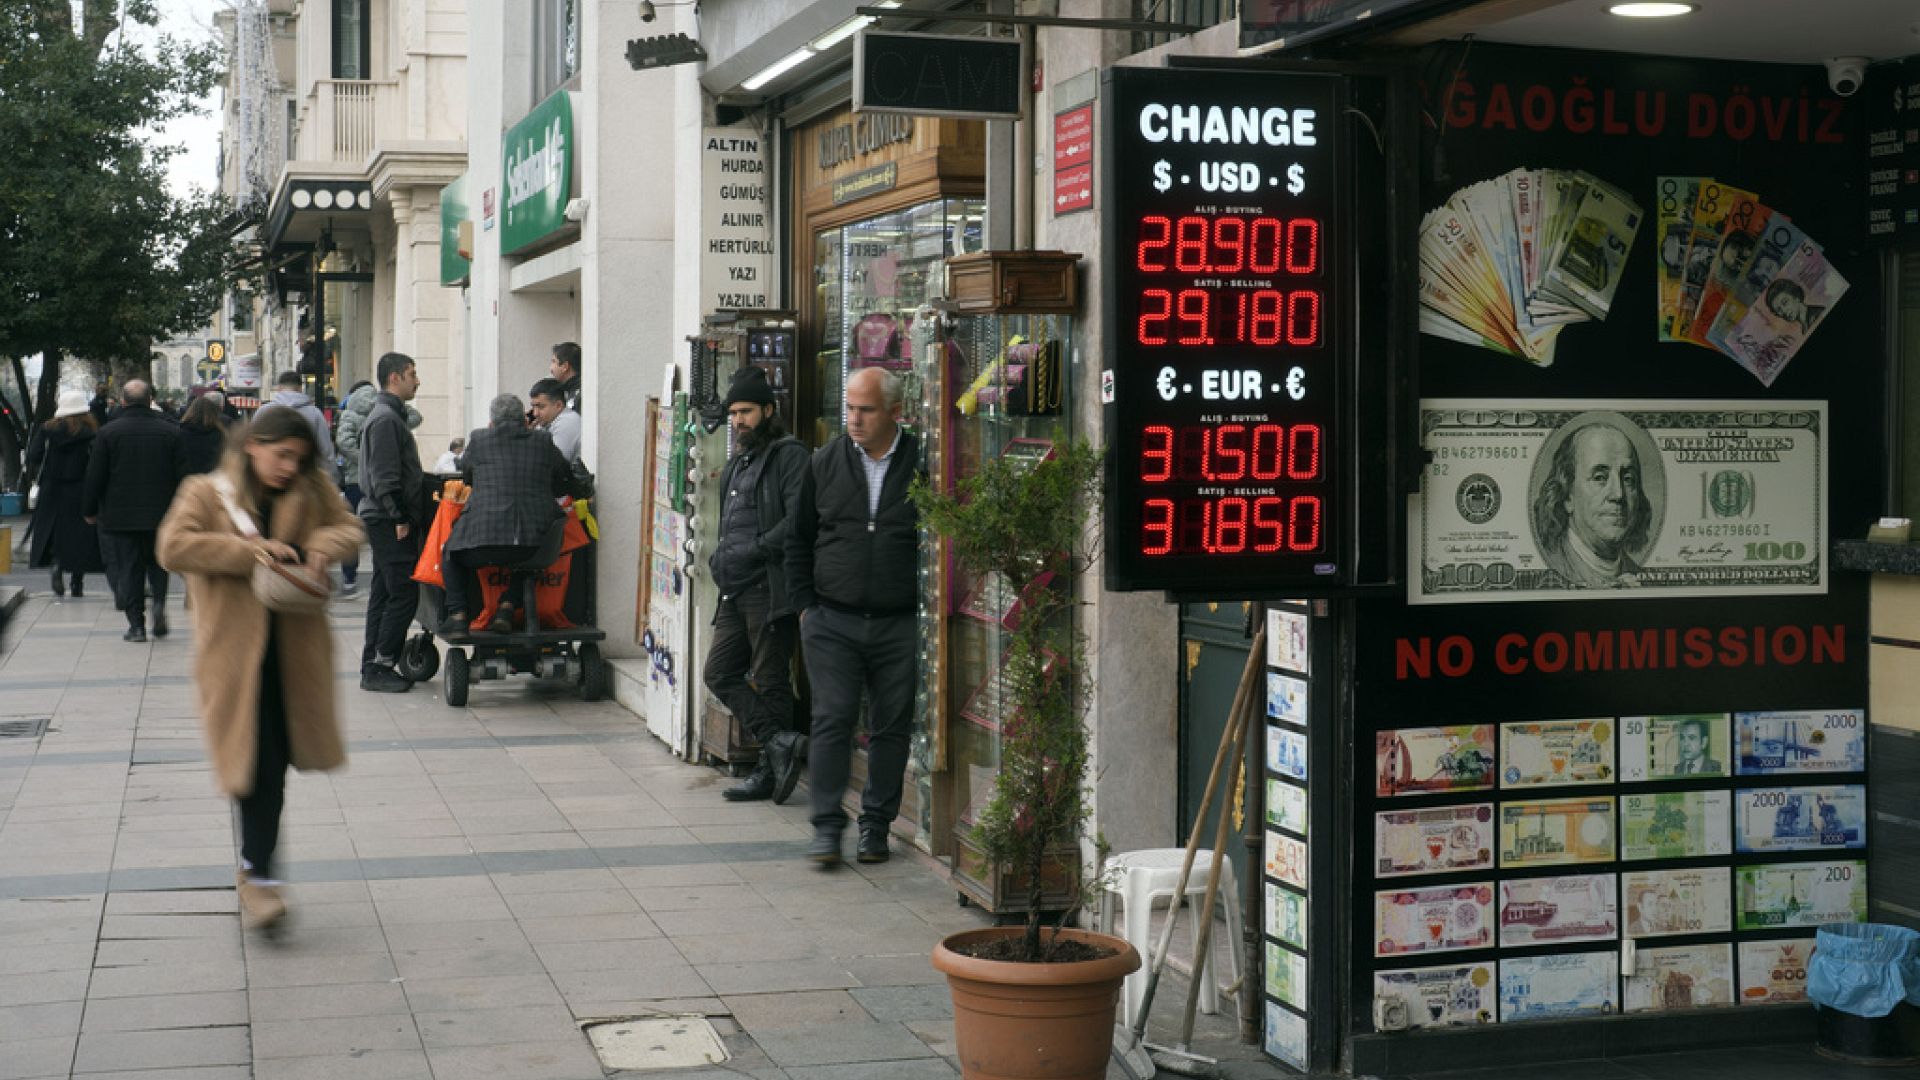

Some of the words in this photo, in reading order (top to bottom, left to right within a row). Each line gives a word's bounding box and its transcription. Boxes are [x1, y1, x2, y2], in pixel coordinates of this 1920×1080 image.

[1140, 103, 1317, 146] CHANGE
[1686, 82, 1846, 144] DÖVİZ
[707, 138, 758, 152] ALTIN
[721, 159, 764, 172] HURDA
[1153, 158, 1173, 193] $
[1200, 161, 1261, 192] USD
[1287, 162, 1306, 196] $
[720, 183, 764, 205] GÜMÜŞ
[1662, 179, 1677, 218] 100
[1700, 184, 1720, 215] 50
[721, 212, 764, 227] ALINIR
[1732, 201, 1755, 229] 20
[1137, 216, 1319, 274] 28.900
[1764, 227, 1792, 258] 10
[728, 266, 757, 280] YAZI
[1193, 279, 1221, 288] SATIŞ
[1230, 280, 1272, 288] SELLING
[717, 293, 766, 307] YAZILIR
[1138, 289, 1319, 345] 29.180
[1156, 366, 1178, 400] €
[1202, 370, 1263, 400] EUR
[1285, 366, 1306, 400] €
[1141, 424, 1321, 482] 31.500
[1197, 487, 1225, 496] SATIŞ
[1233, 487, 1276, 495] SELLING
[1142, 496, 1321, 555] 31.850
[1744, 541, 1806, 561] 100
[1396, 636, 1475, 680] NO
[1496, 625, 1846, 675] COMMISSION
[1626, 722, 1643, 735] 50
[1824, 715, 1857, 729] 2000
[1752, 791, 1786, 808] 2000
[1826, 866, 1851, 882] 200
